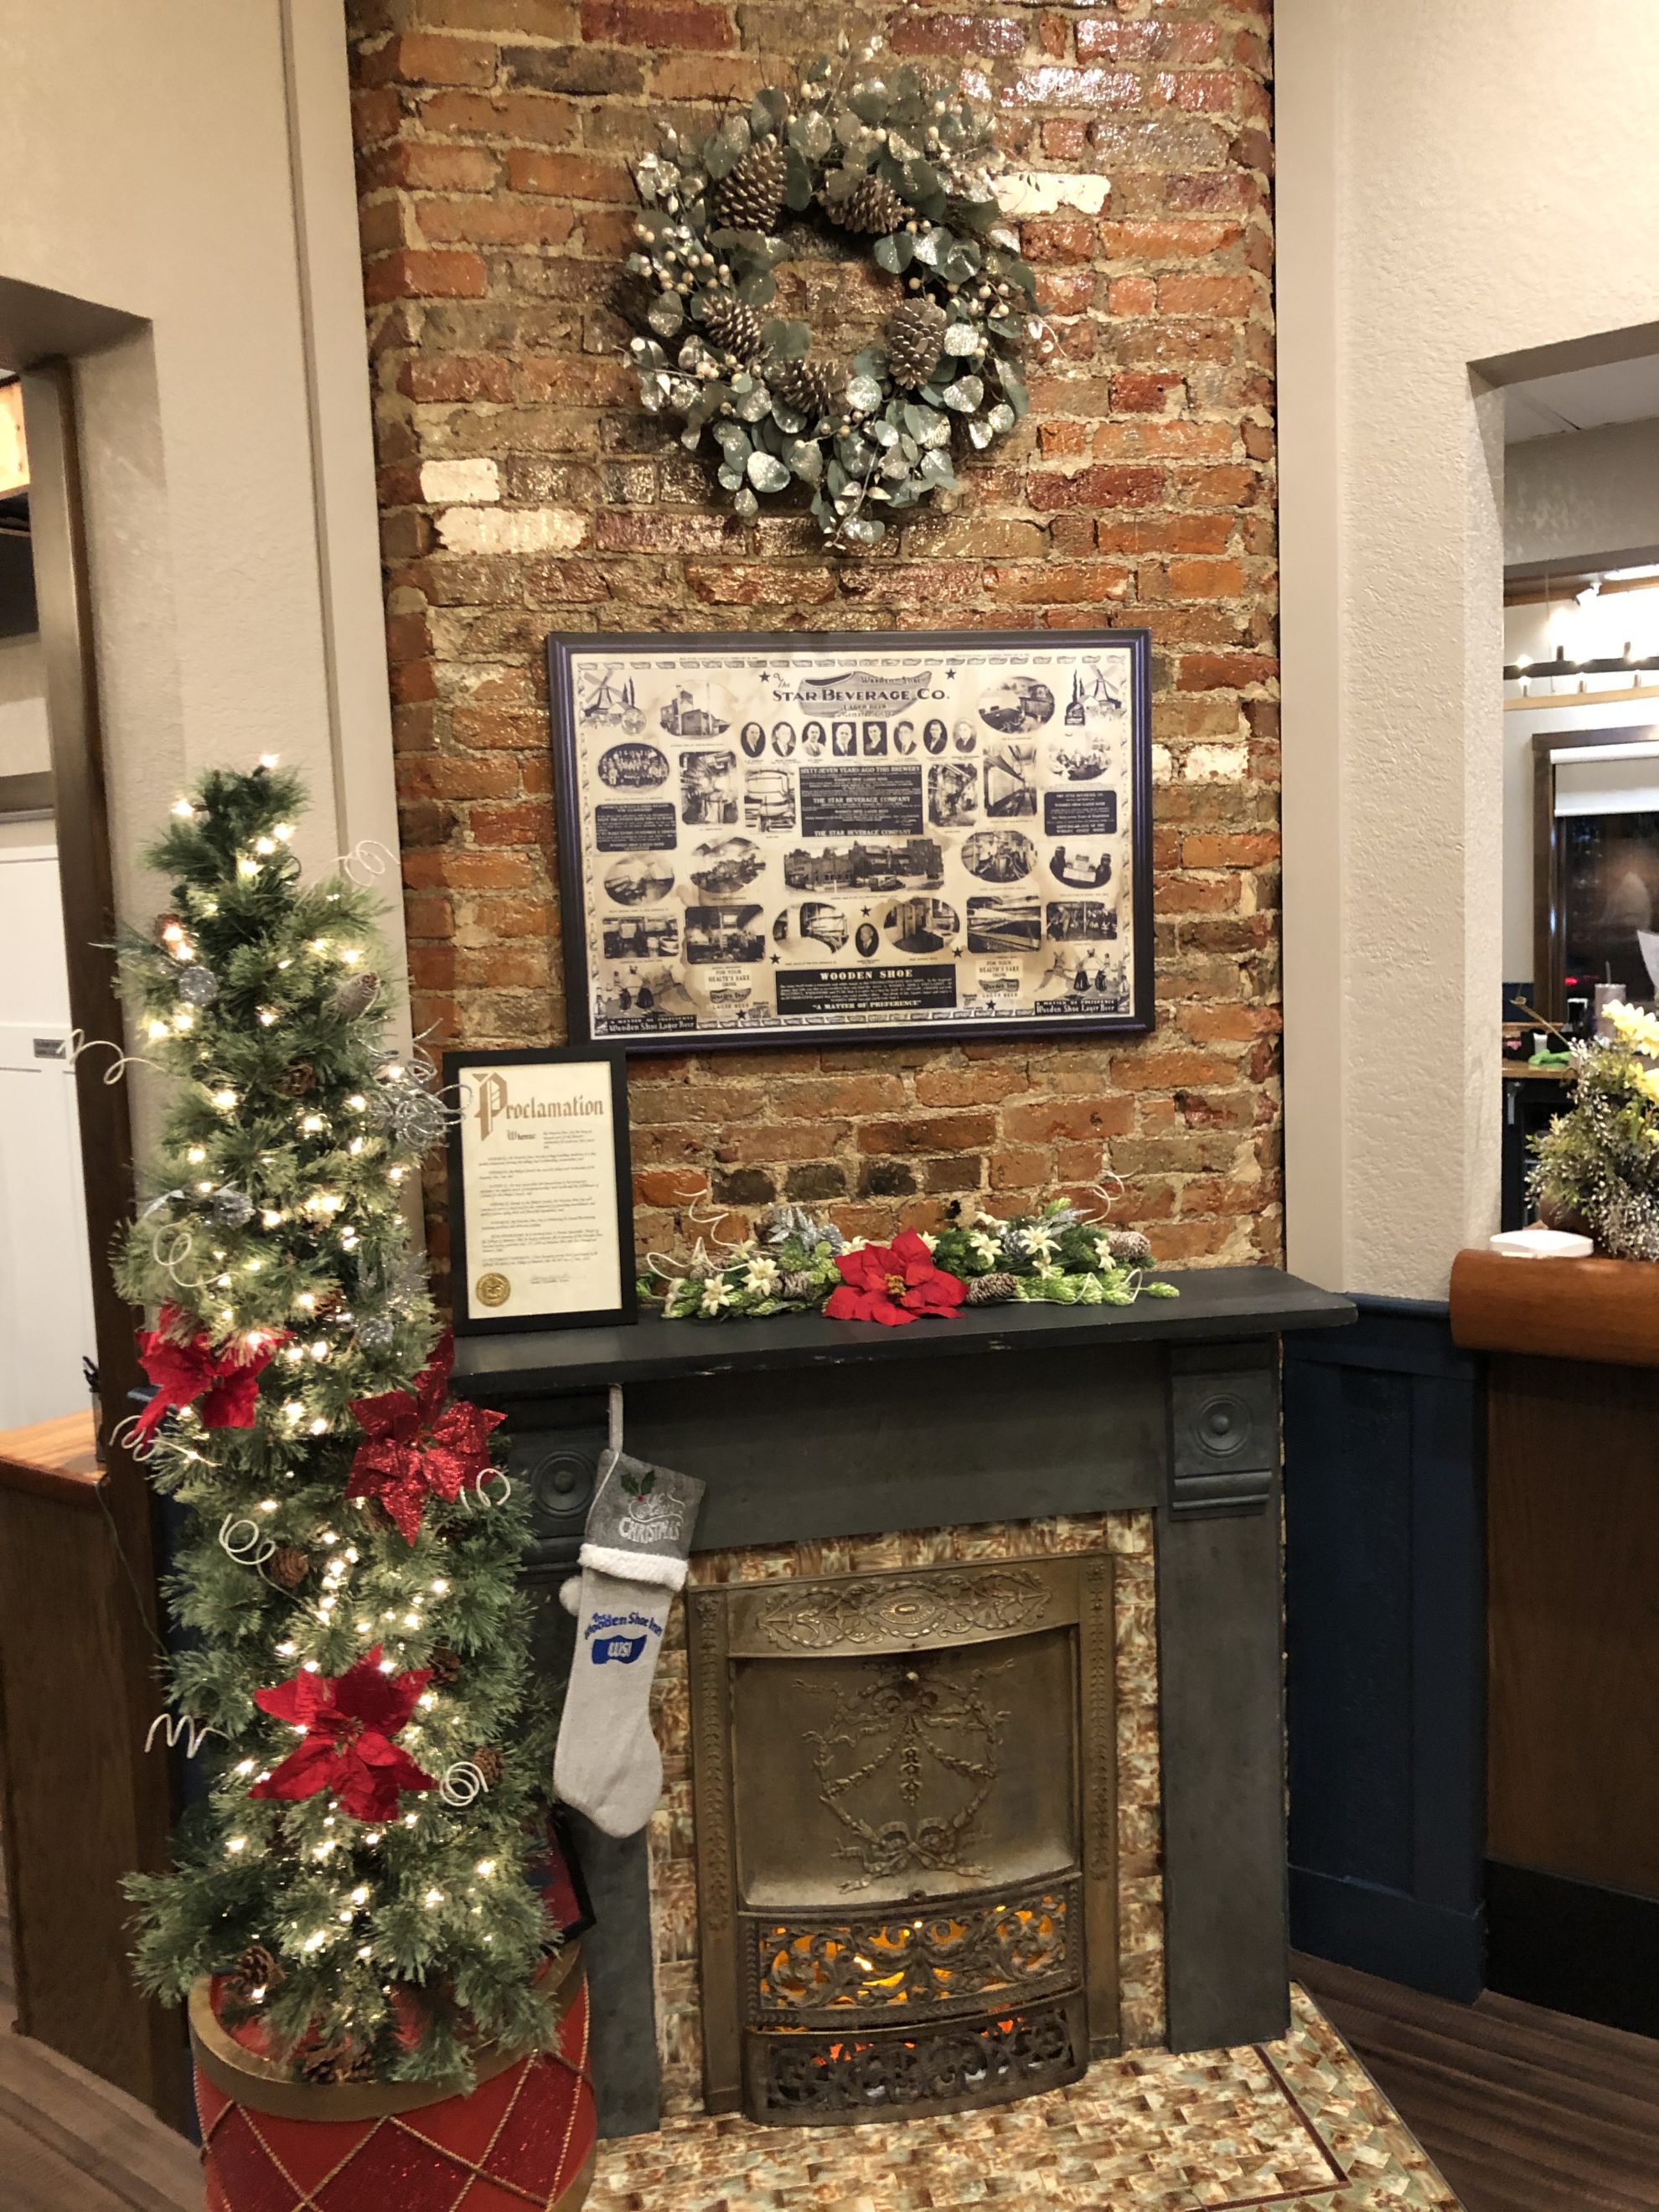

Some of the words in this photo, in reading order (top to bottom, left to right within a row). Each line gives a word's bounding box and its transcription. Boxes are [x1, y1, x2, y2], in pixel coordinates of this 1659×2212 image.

[773, 690, 818, 702] STAR
[821, 689, 911, 701] BEVERAGE
[819, 971, 872, 980] WOODEN
[879, 969, 913, 979] SHOE
[472, 1072, 604, 1141] Proclamation
[619, 1517, 681, 1543] CHRISTMAS
[584, 1616, 627, 1640] Wooden
[628, 1611, 649, 1627] Shoe
